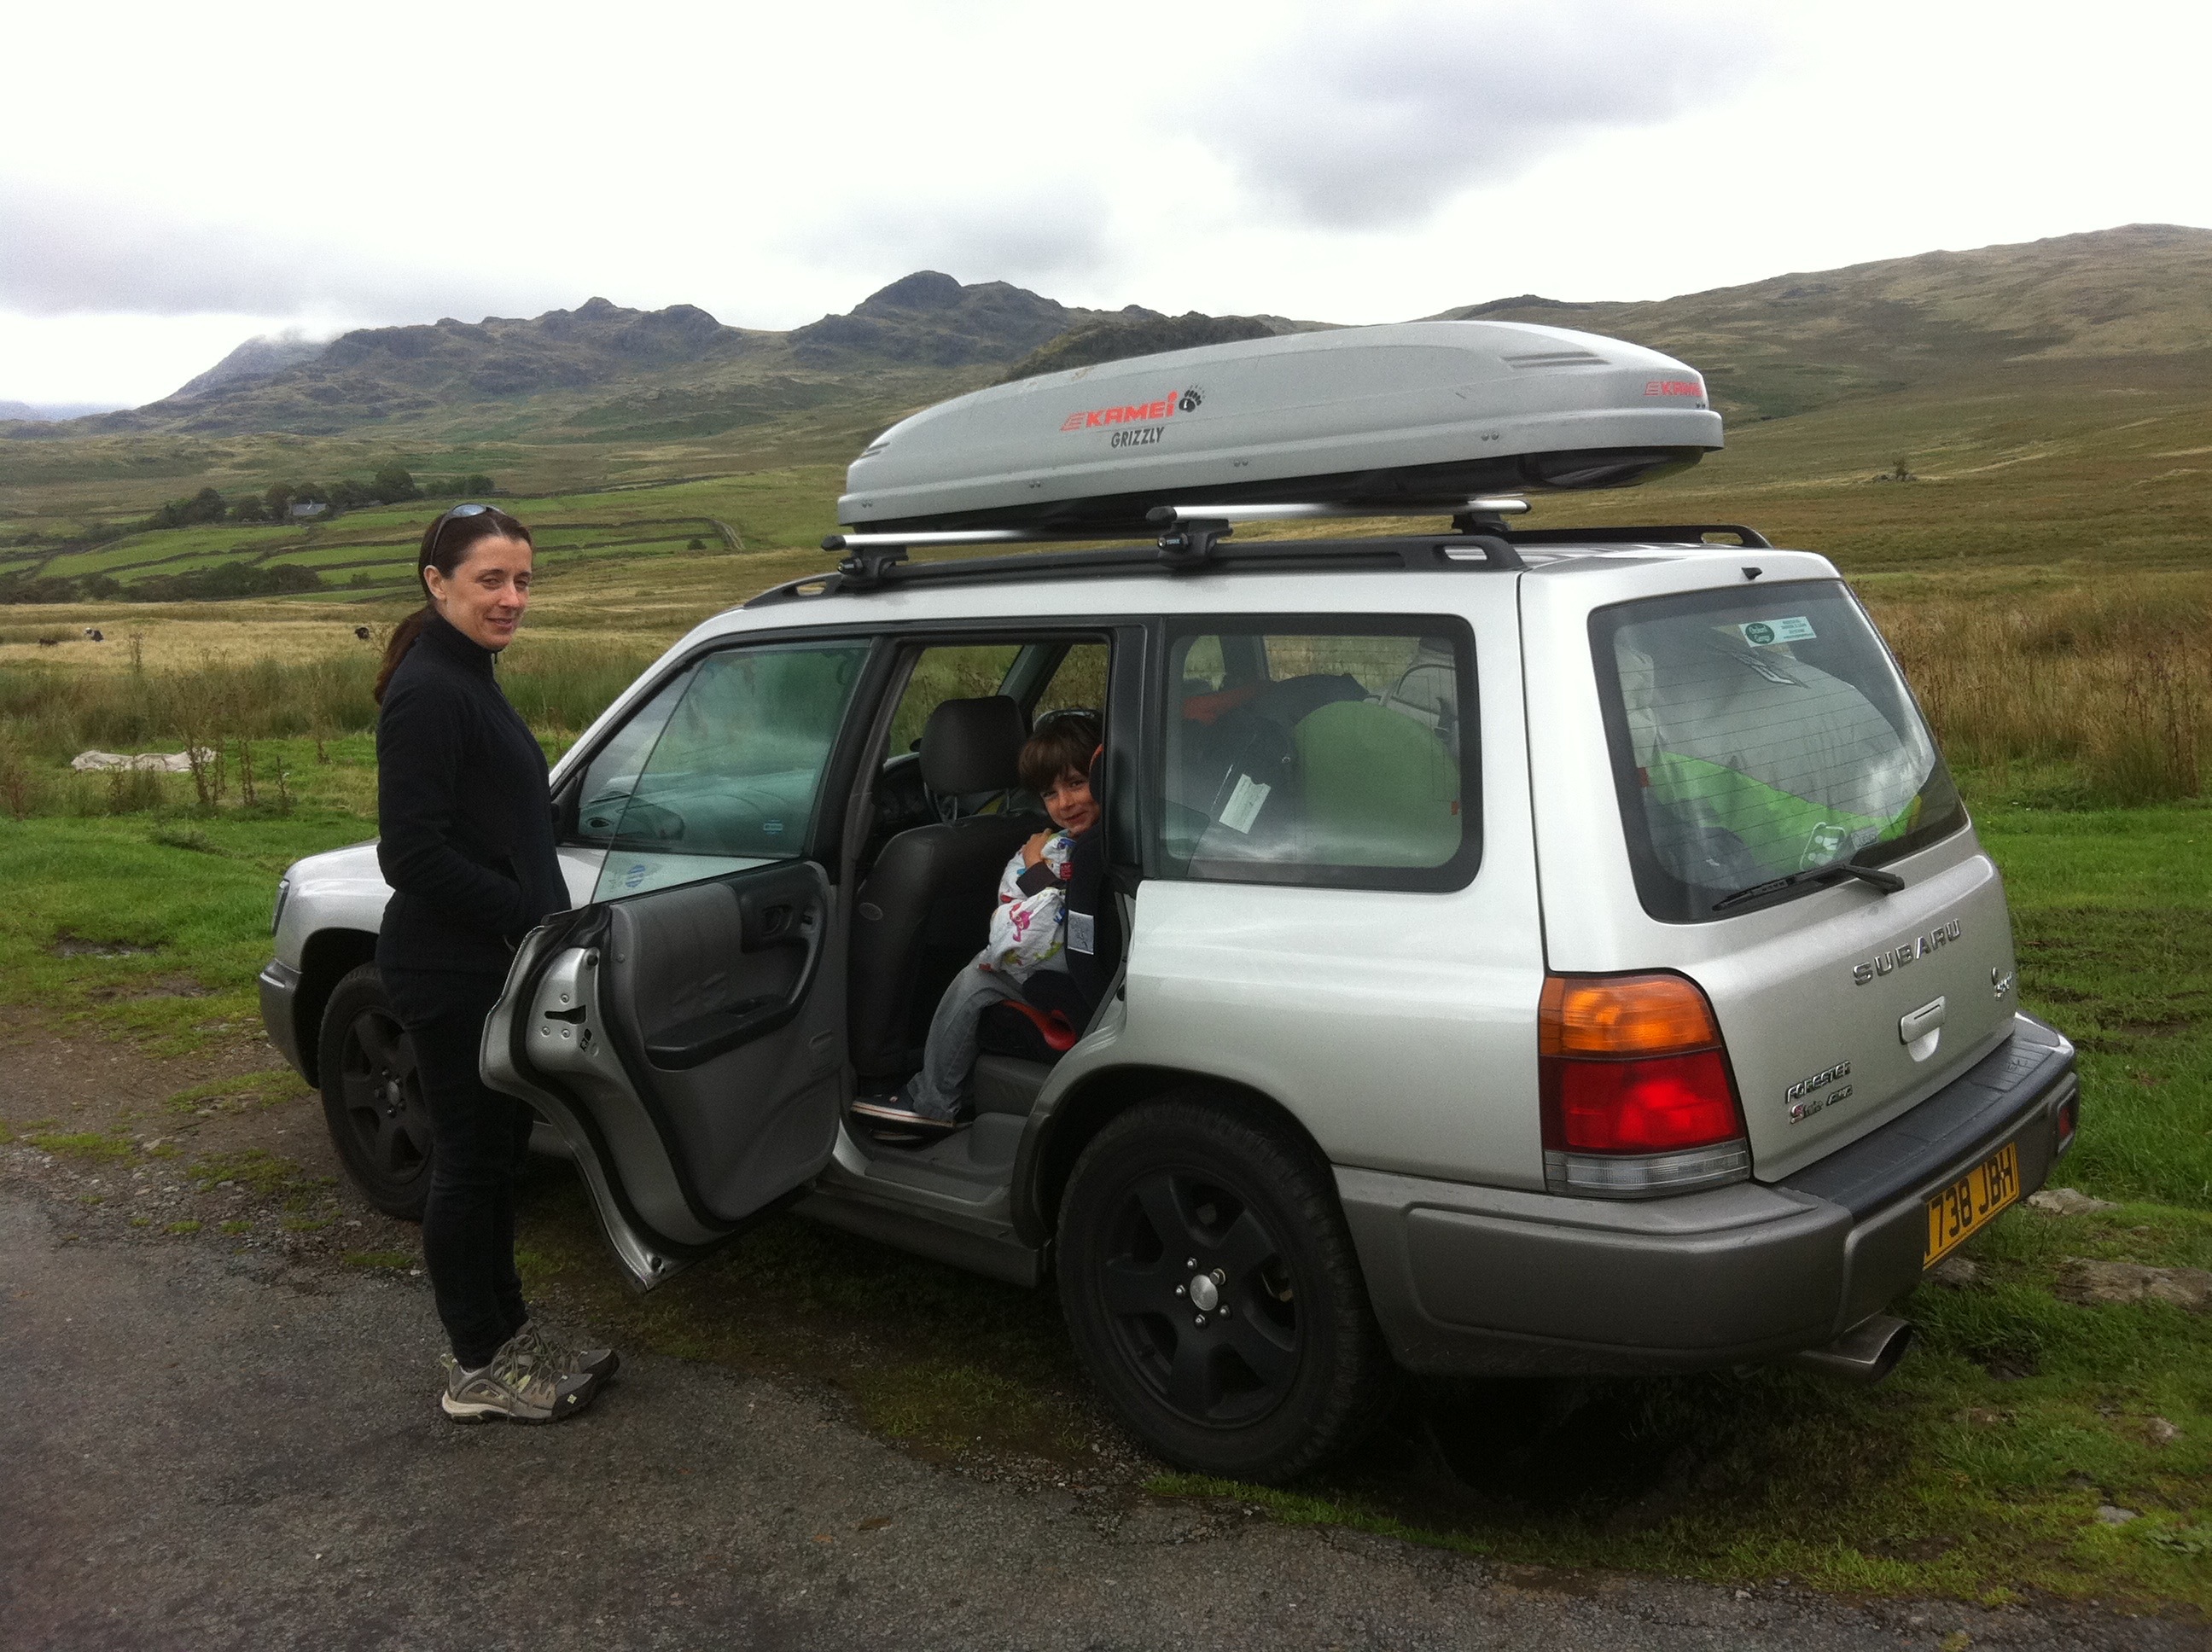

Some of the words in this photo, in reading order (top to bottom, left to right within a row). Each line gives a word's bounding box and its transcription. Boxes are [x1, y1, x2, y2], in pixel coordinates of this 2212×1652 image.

[1111, 427, 1165, 449] GRIZZLY
[1853, 917, 1961, 986] SUBARU
[1786, 1060, 1851, 1104] FORESTER
[1978, 1147, 2015, 1214] JBH
